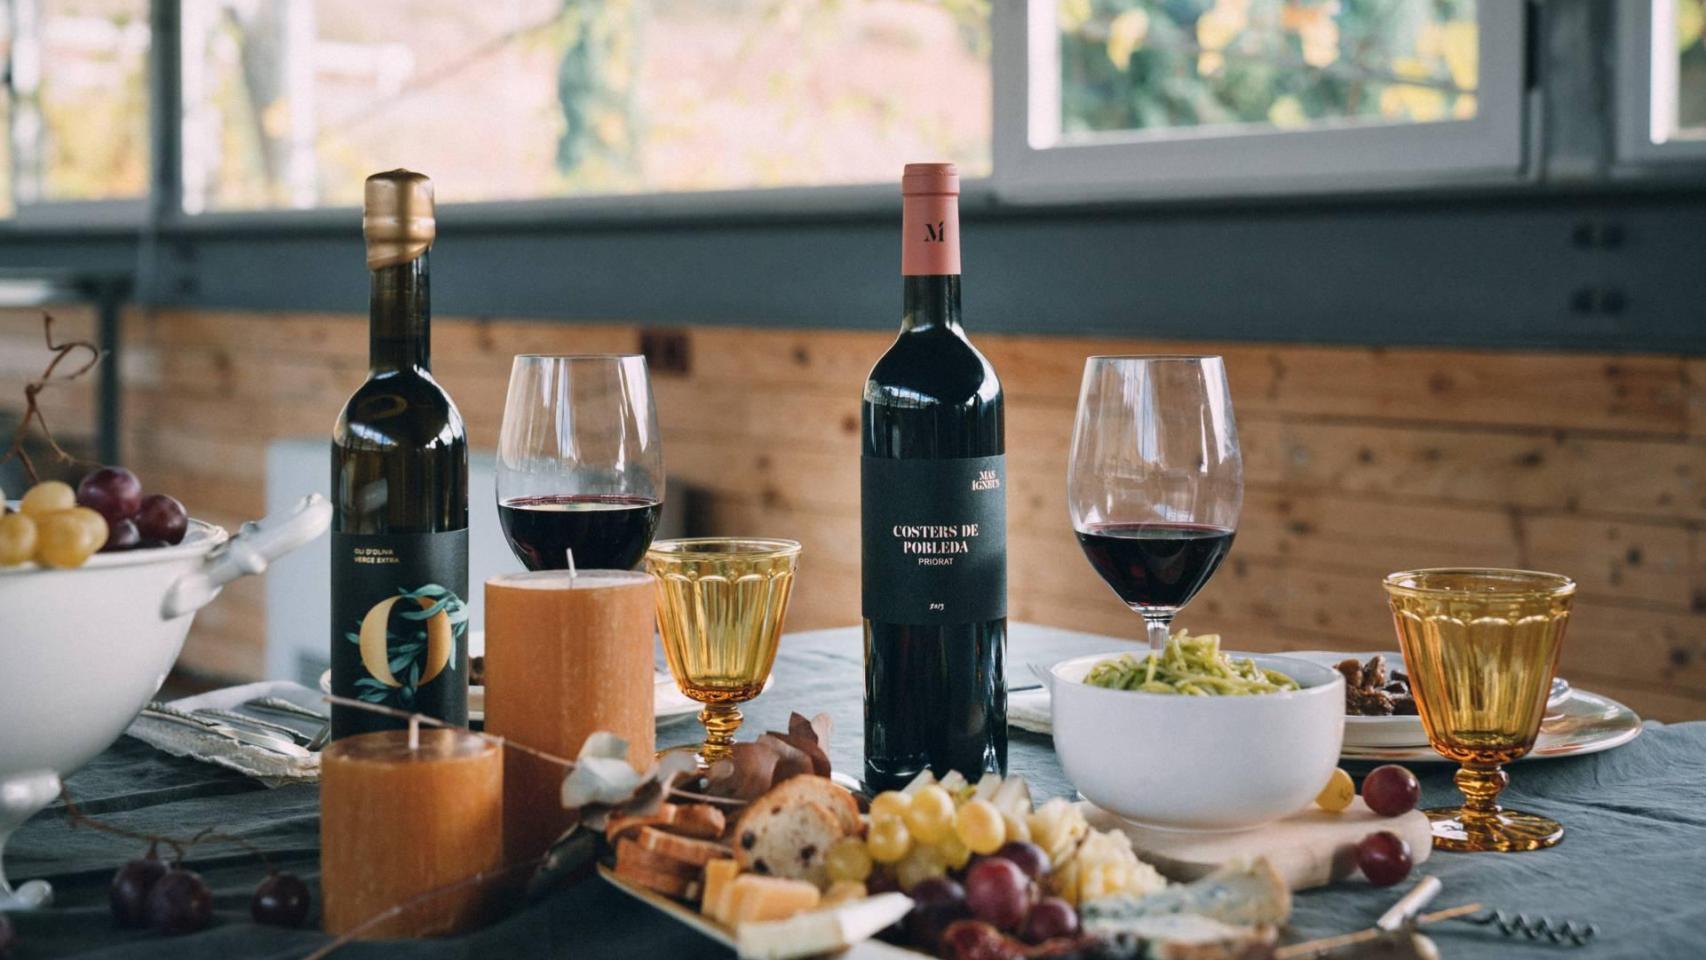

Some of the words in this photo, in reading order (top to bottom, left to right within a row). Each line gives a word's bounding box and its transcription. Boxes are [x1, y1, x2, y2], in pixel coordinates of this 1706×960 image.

[979, 470, 997, 480] MAS
[893, 525, 958, 538] COSTERS
[962, 524, 979, 537] DE
[903, 541, 969, 554] POBLEDA
[918, 558, 954, 566] PRIORAT
